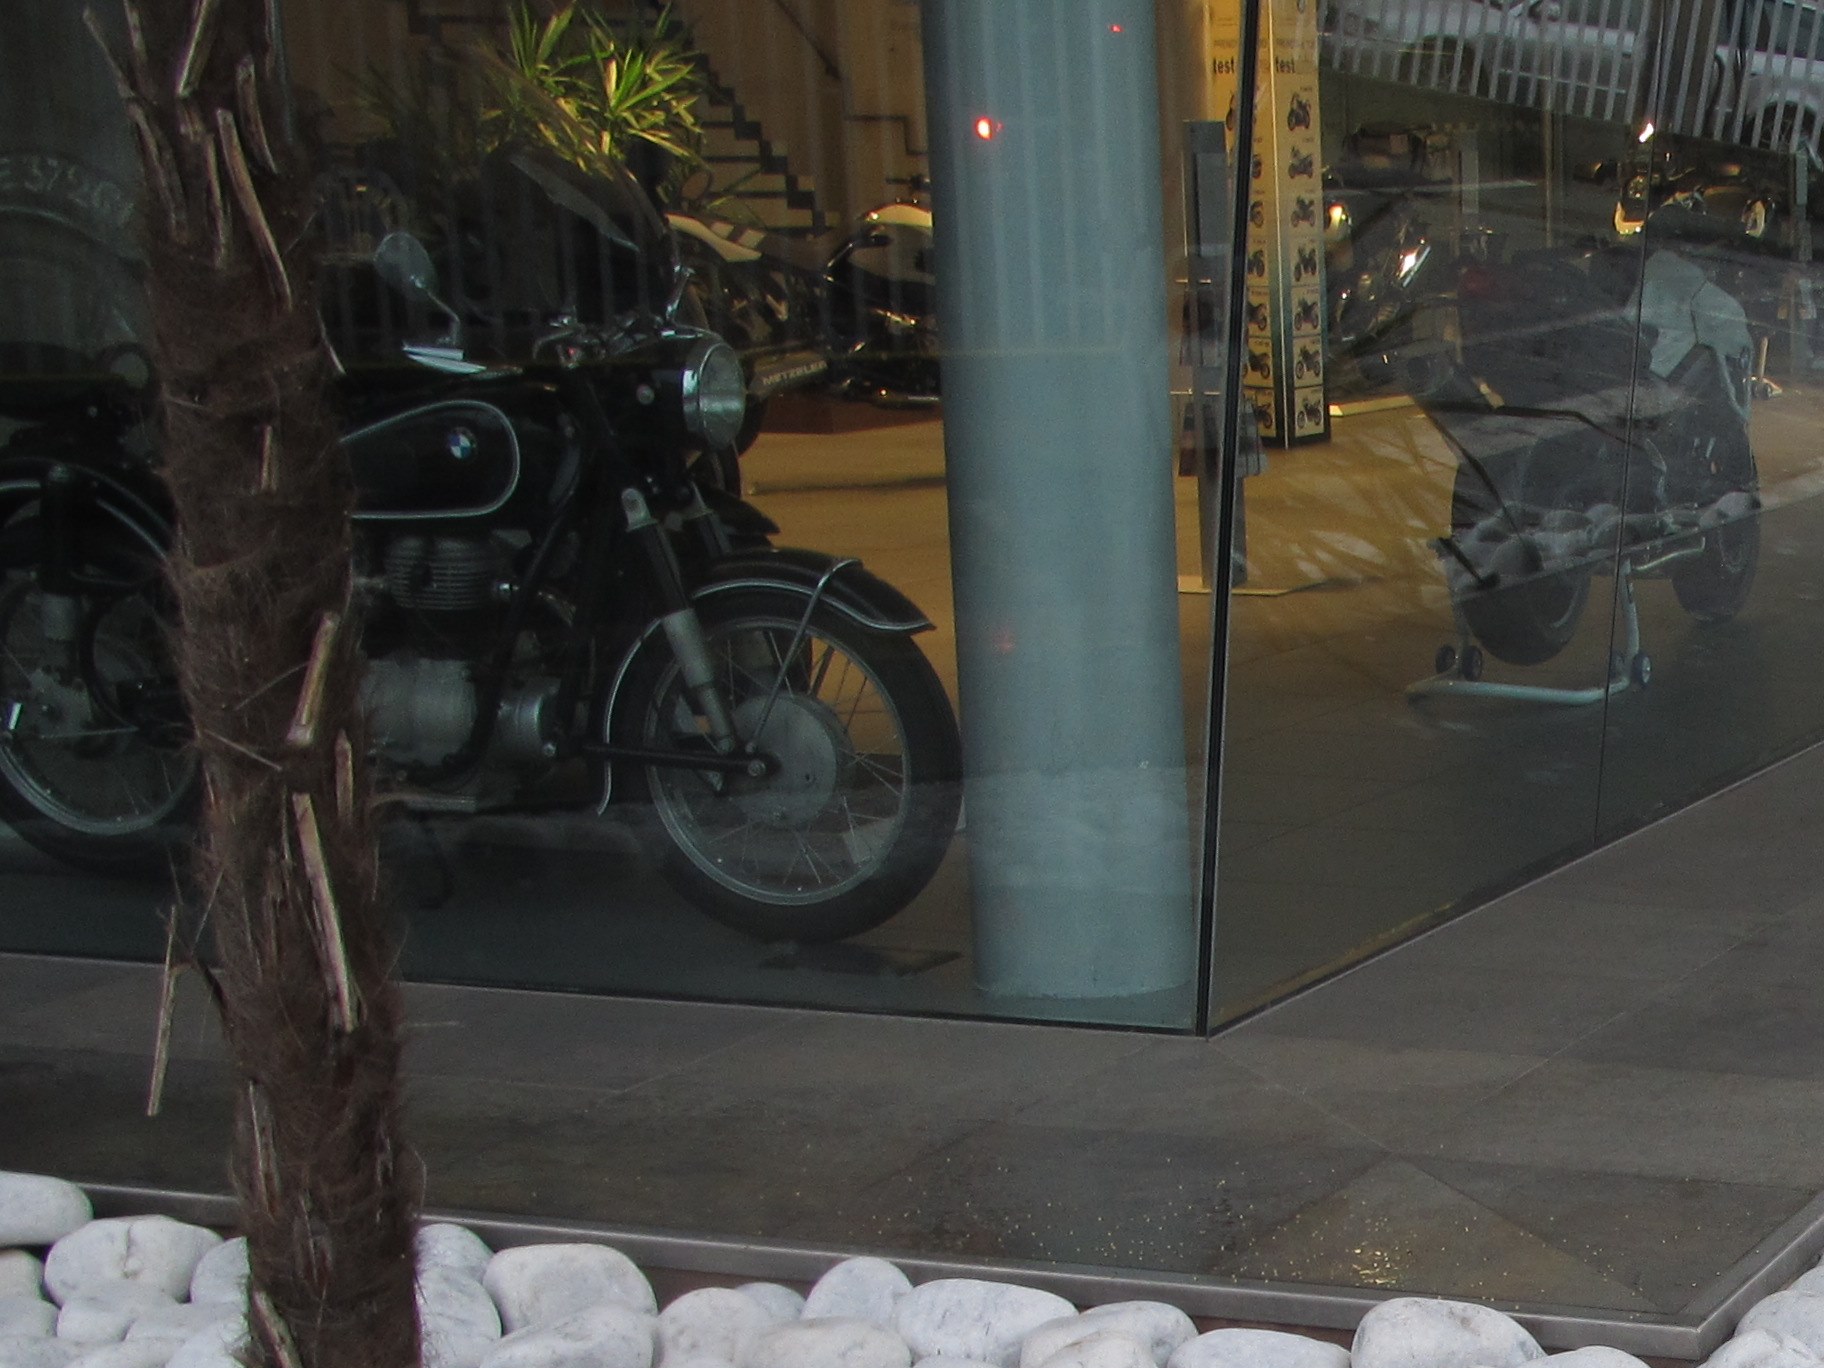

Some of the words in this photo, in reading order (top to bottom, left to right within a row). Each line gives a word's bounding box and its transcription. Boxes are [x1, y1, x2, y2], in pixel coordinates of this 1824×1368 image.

[1213, 56, 1235, 74] test
[1276, 56, 1296, 74] test
[763, 361, 826, 383] METZELER
